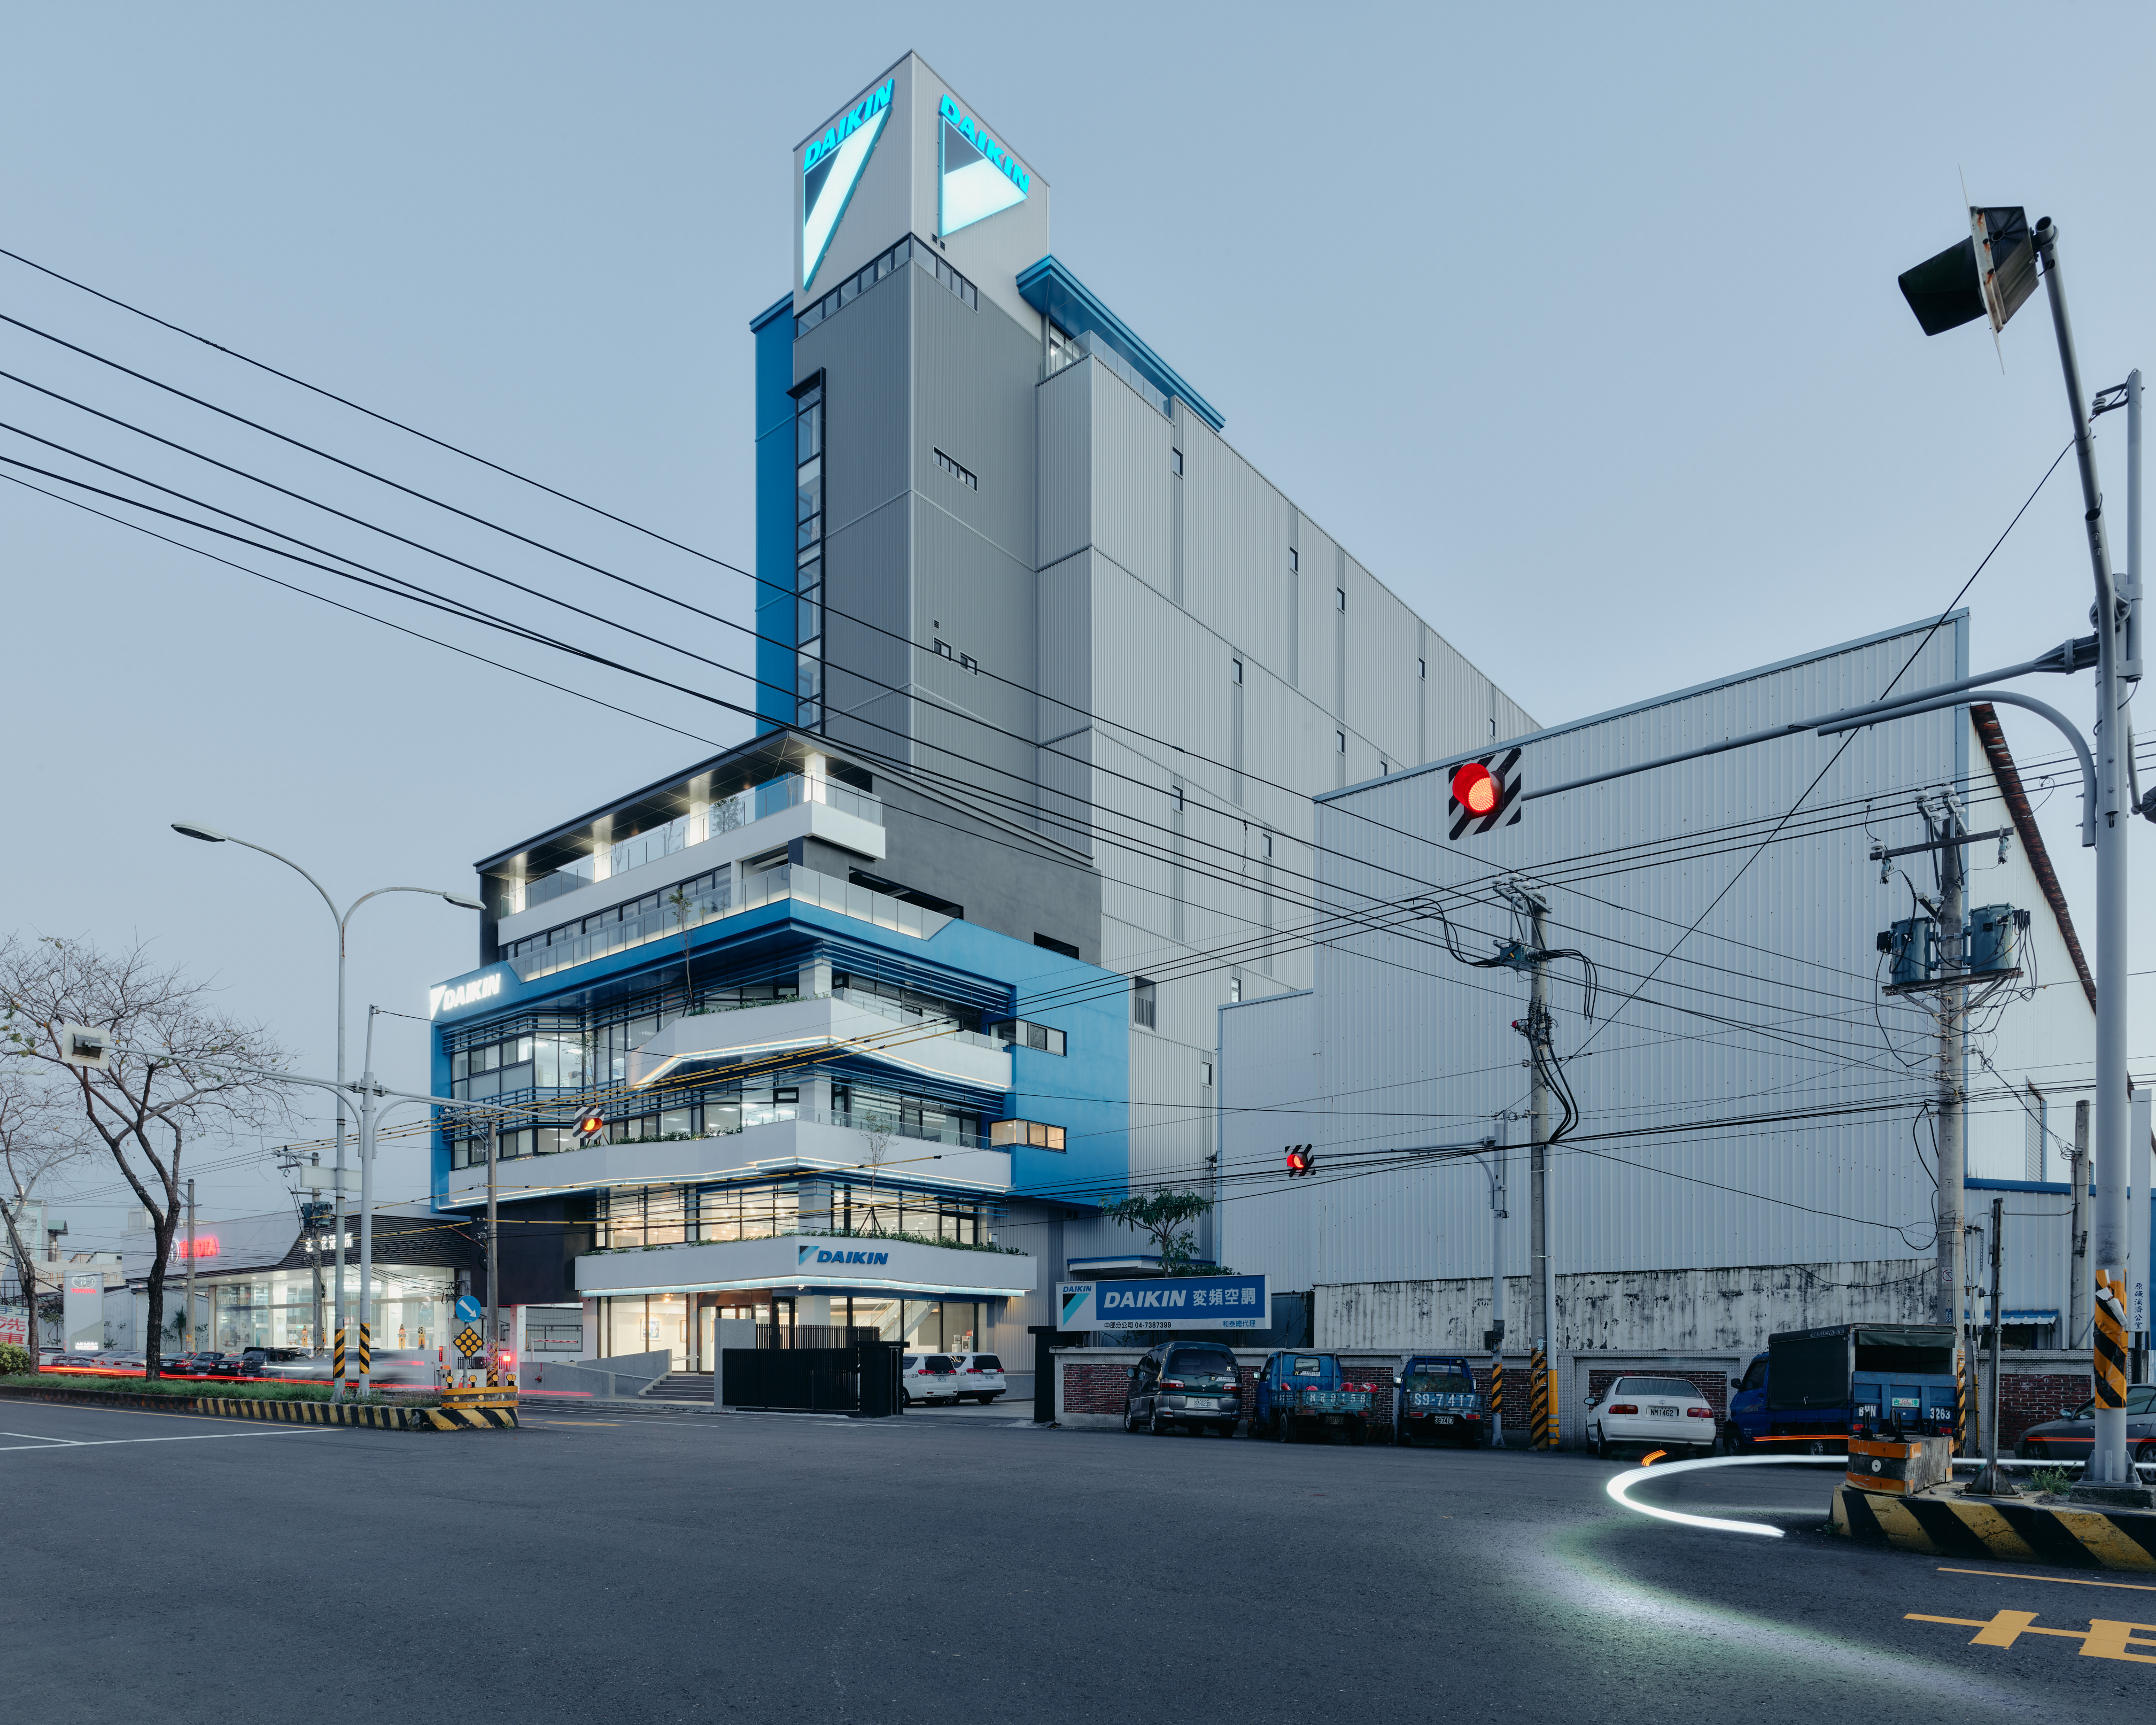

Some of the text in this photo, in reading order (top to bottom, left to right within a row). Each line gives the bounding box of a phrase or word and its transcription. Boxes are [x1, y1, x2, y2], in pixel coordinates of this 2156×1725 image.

[803, 78, 895, 172] DAIKIN
[939, 94, 1030, 194] DAIKIN
[443, 973, 501, 1010] DAIKIN
[817, 1250, 889, 1265] DAIKIN
[1104, 1290, 1187, 1308] DAIKIN
[0, 1332, 25, 1344] 車
[1414, 1393, 1475, 1407] S9-7417
[1930, 1407, 1951, 1419] 3263
